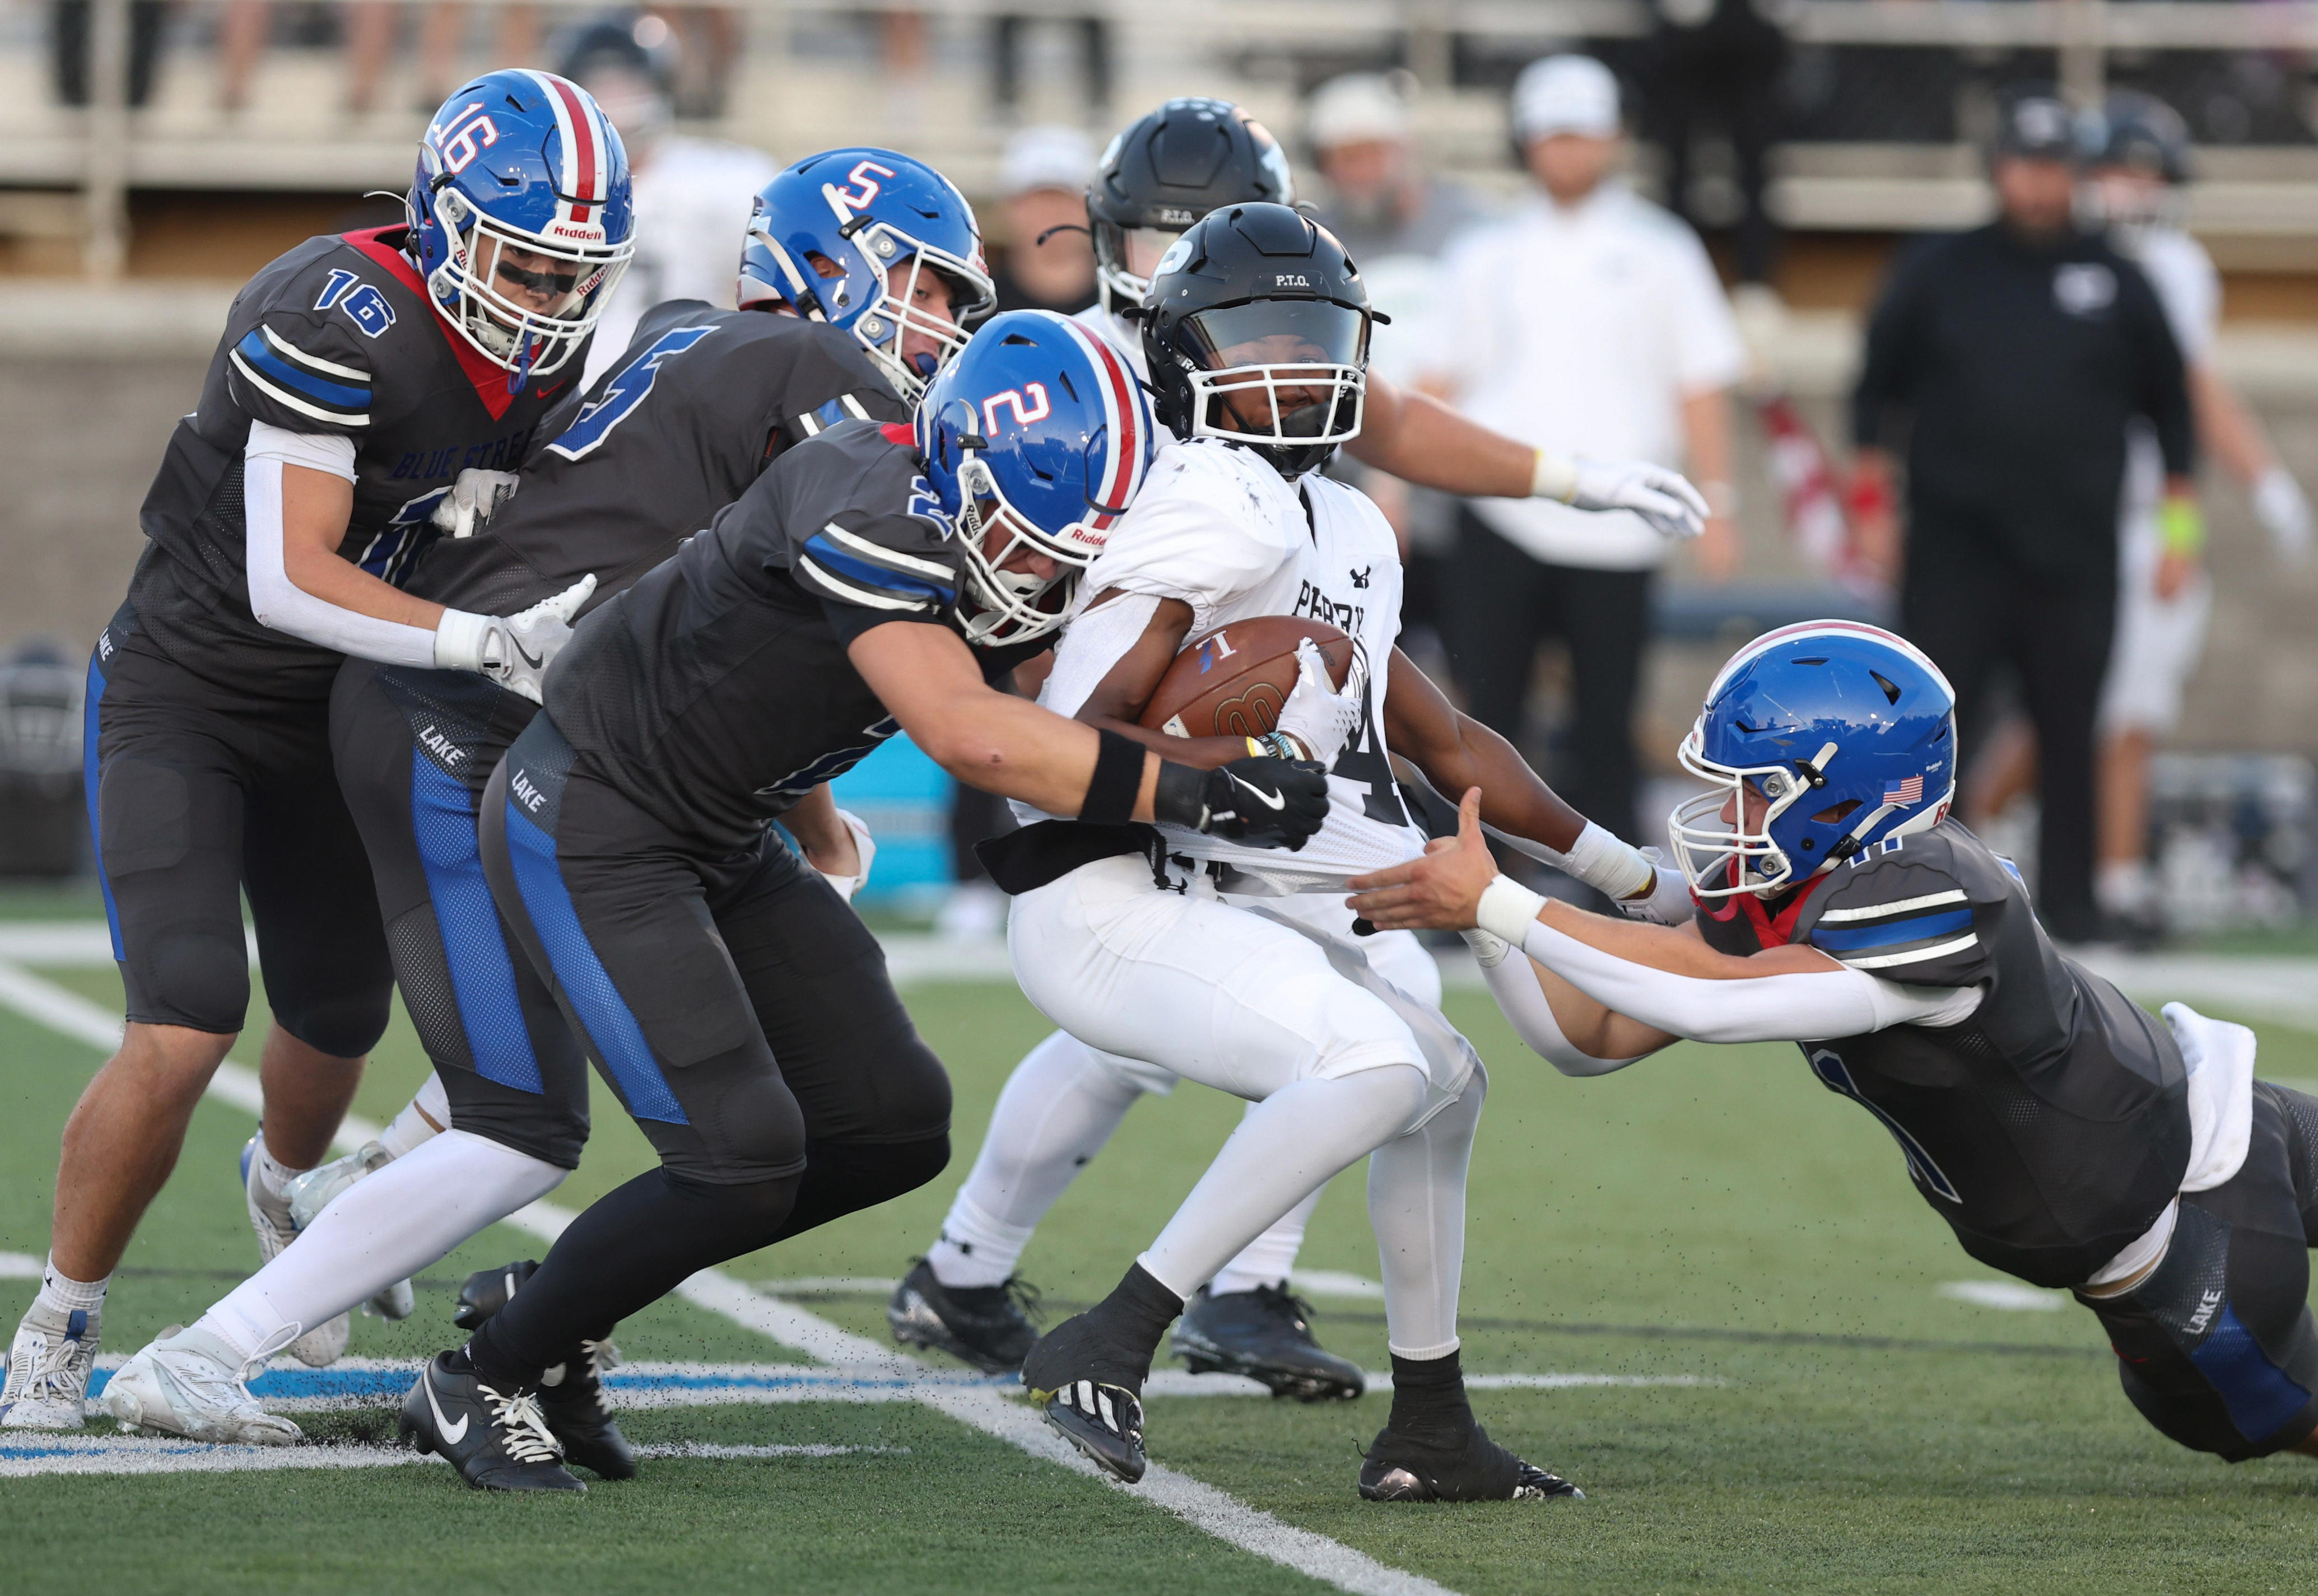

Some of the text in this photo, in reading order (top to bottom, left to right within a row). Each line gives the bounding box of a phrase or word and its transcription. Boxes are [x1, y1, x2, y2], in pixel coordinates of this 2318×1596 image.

[435, 102, 499, 174] 16
[837, 161, 896, 210] 5
[554, 226, 602, 240] Riddell
[576, 263, 609, 296] Ridde
[1276, 275, 1310, 287] P.T.O.
[313, 268, 396, 338] 16
[983, 381, 1052, 437] 2
[390, 429, 524, 479] BLUE STRE
[1072, 529, 1107, 545] Ridde
[1292, 578, 1364, 633] PERRY
[99, 627, 113, 662] LAKE
[419, 725, 465, 766] LAKE
[511, 768, 547, 813] LAKE
[2180, 1289, 2223, 1336] LAKE
